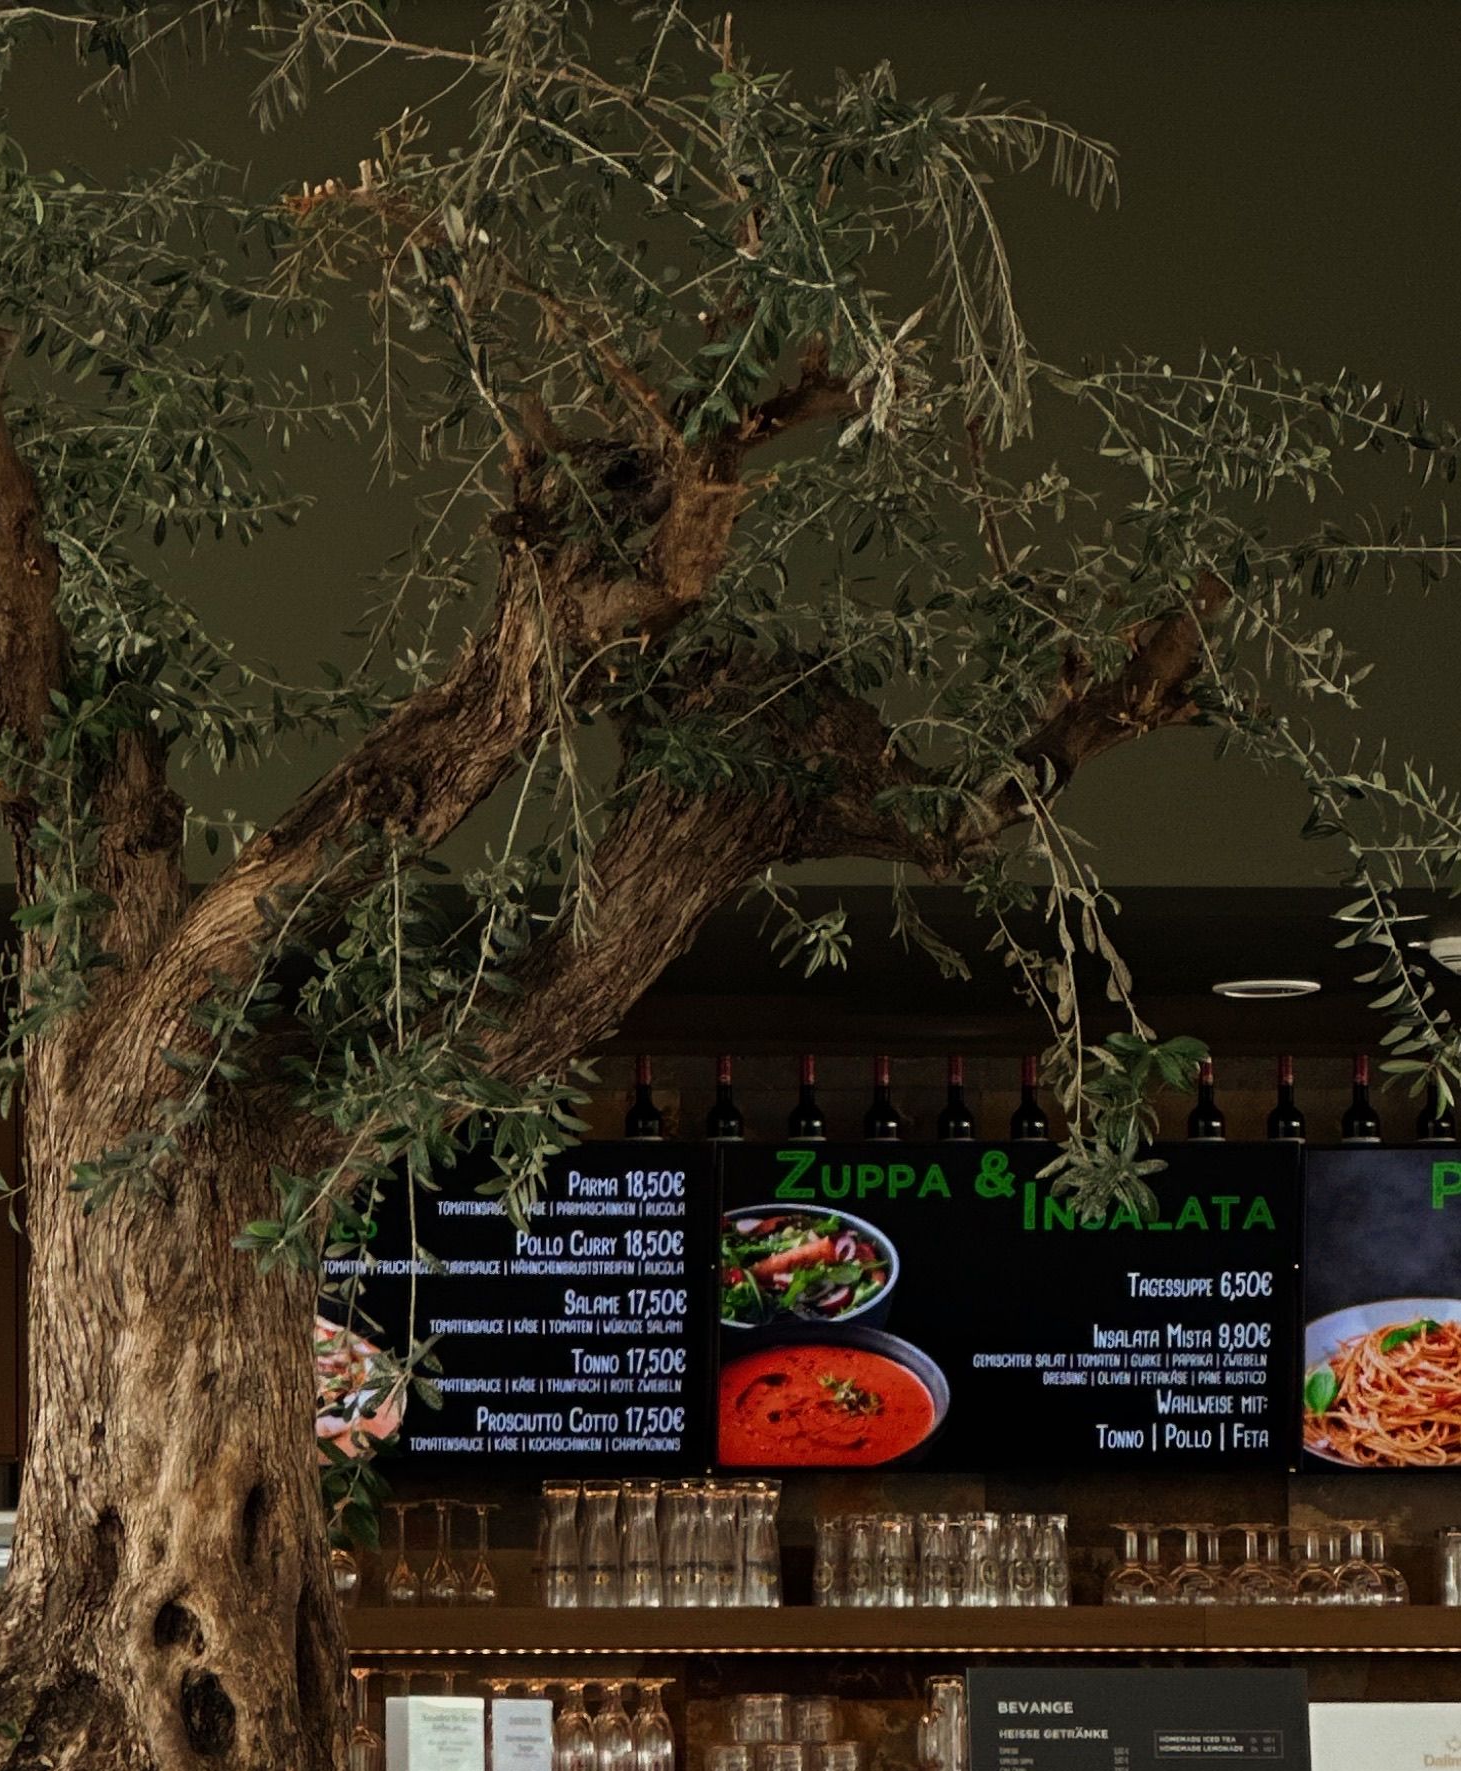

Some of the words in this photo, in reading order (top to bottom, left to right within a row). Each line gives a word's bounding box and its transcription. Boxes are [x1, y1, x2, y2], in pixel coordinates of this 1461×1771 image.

[568, 1170, 618, 1197] PARMA
[625, 1170, 685, 1201] 18,50€
[774, 1150, 952, 1199] ZUPPA
[974, 1150, 1016, 1198] &
[645, 1202, 685, 1216] RUCOLA
[1024, 1181, 1276, 1231] INAATA
[516, 1230, 563, 1256] POLLO
[570, 1230, 618, 1256] CURRY
[624, 1230, 684, 1260] 18,50€
[644, 1261, 684, 1275] RUCOLA
[1127, 1272, 1213, 1297] TAGESSUPPE
[1220, 1271, 1273, 1301] 6,50€
[564, 1289, 620, 1315] SALAME
[628, 1289, 687, 1319] 17,50€
[430, 1319, 504, 1334] TOMATENSAUCE
[514, 1317, 538, 1334] KÄSE
[549, 1319, 593, 1334] TOMATEN
[647, 1319, 682, 1334] SALAMI
[1093, 1323, 1159, 1349] INSALATA
[1167, 1323, 1212, 1348] MISTA
[571, 1348, 620, 1374] TONNO
[627, 1348, 686, 1377] 17,50€
[1035, 1353, 1066, 1368] SALAT
[1077, 1353, 1121, 1368] TOMATEN
[1130, 1353, 1162, 1368] GURKE
[1172, 1353, 1213, 1368] PAPRIKA
[1223, 1353, 1268, 1368] ZWIEBELN
[430, 1378, 502, 1393] OMATENSAUCE
[512, 1376, 536, 1393] KÄSE
[547, 1378, 601, 1393] THUNFISCH
[610, 1378, 634, 1393] ROTE
[638, 1378, 682, 1393] ZWIEBELN
[1097, 1371, 1131, 1385] OLIVEN
[1198, 1371, 1222, 1385] PANE
[1225, 1371, 1267, 1385] RUSTICO
[1156, 1389, 1234, 1414] WAHLWEISE
[477, 1406, 562, 1432] PROSCIUTTO
[569, 1406, 619, 1432] COTTO
[625, 1406, 685, 1436] 17,50€
[410, 1437, 484, 1451] TOMATENSAUCE
[494, 1435, 518, 1451] KÄSE
[529, 1437, 602, 1451] KOCHSCHINKEN
[612, 1437, 681, 1452] CHAMPIGNONS
[1096, 1423, 1144, 1449] TONNO
[1165, 1423, 1212, 1449] POLLO
[1233, 1423, 1269, 1448] FETA
[997, 1701, 1074, 1714] BEVANGE
[999, 1729, 1040, 1739] HEISSE
[1043, 1726, 1109, 1739] GETRÄNKE
